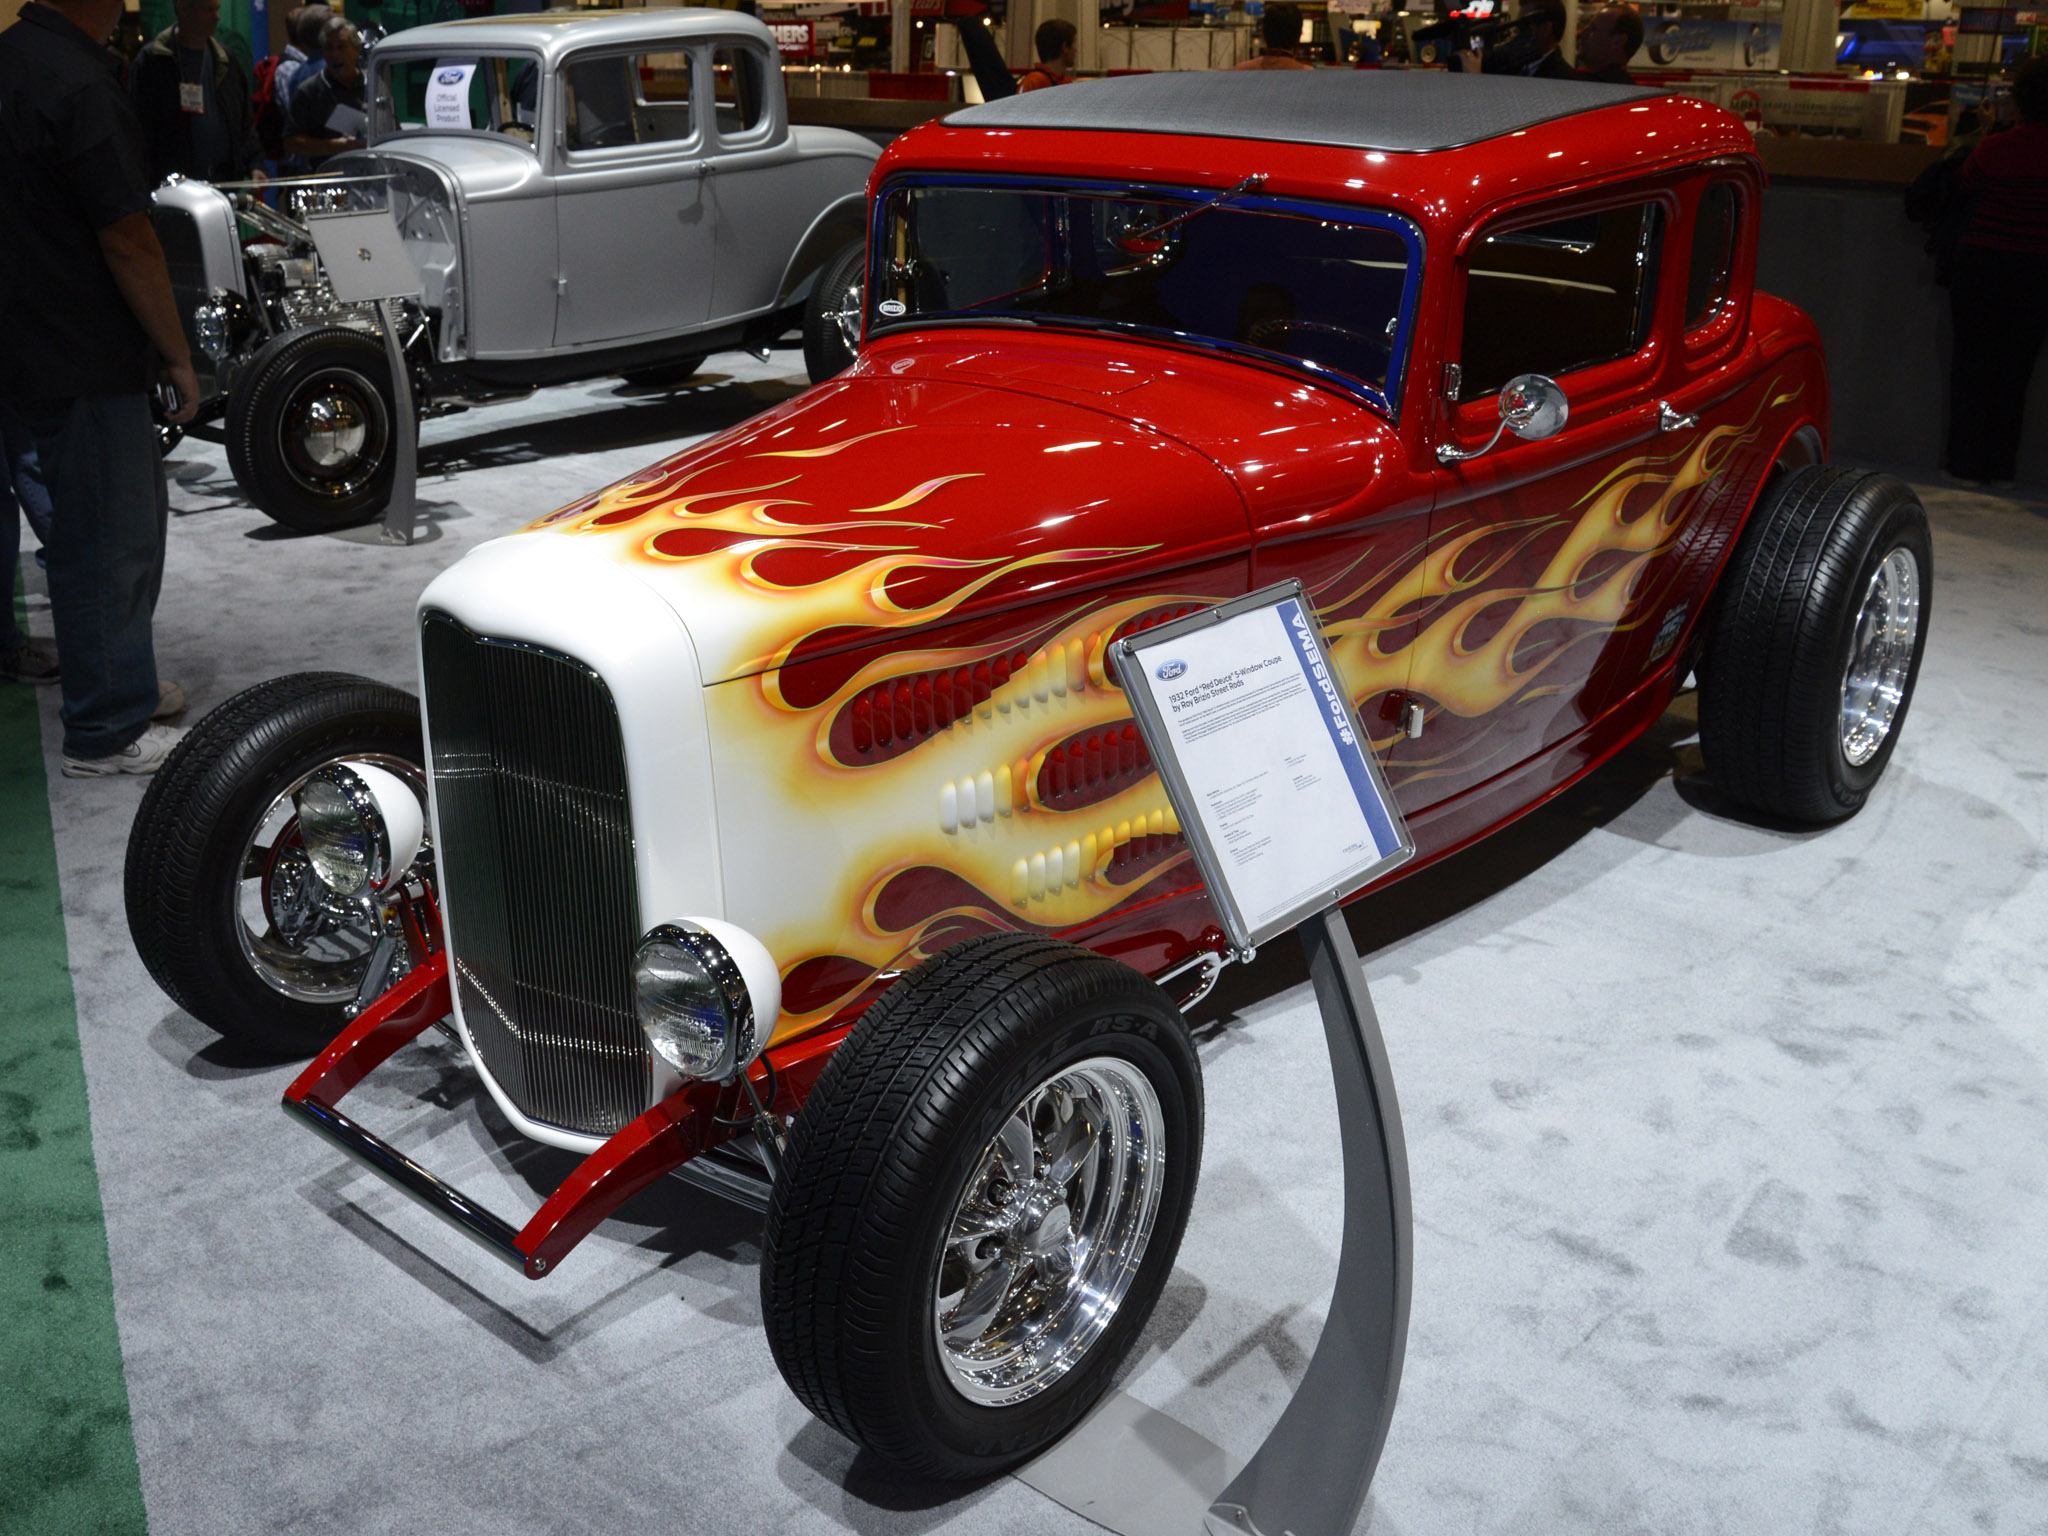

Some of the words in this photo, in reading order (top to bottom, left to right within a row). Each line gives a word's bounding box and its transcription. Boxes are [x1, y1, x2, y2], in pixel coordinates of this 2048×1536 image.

[436, 94, 457, 102] Official
[434, 104, 460, 112] Licensed
[436, 114, 460, 122] Product
[1162, 663, 1182, 679] Ford
[1168, 691, 1185, 704] 1932
[1185, 686, 1200, 698] Ford
[1234, 662, 1264, 679] 5-Window
[1263, 655, 1282, 668] Coupe
[1172, 704, 1181, 713] by
[1181, 699, 1194, 710] Roy
[1194, 692, 1211, 704] Brizio
[1211, 685, 1229, 698] Street
[1228, 679, 1245, 691] Rods
